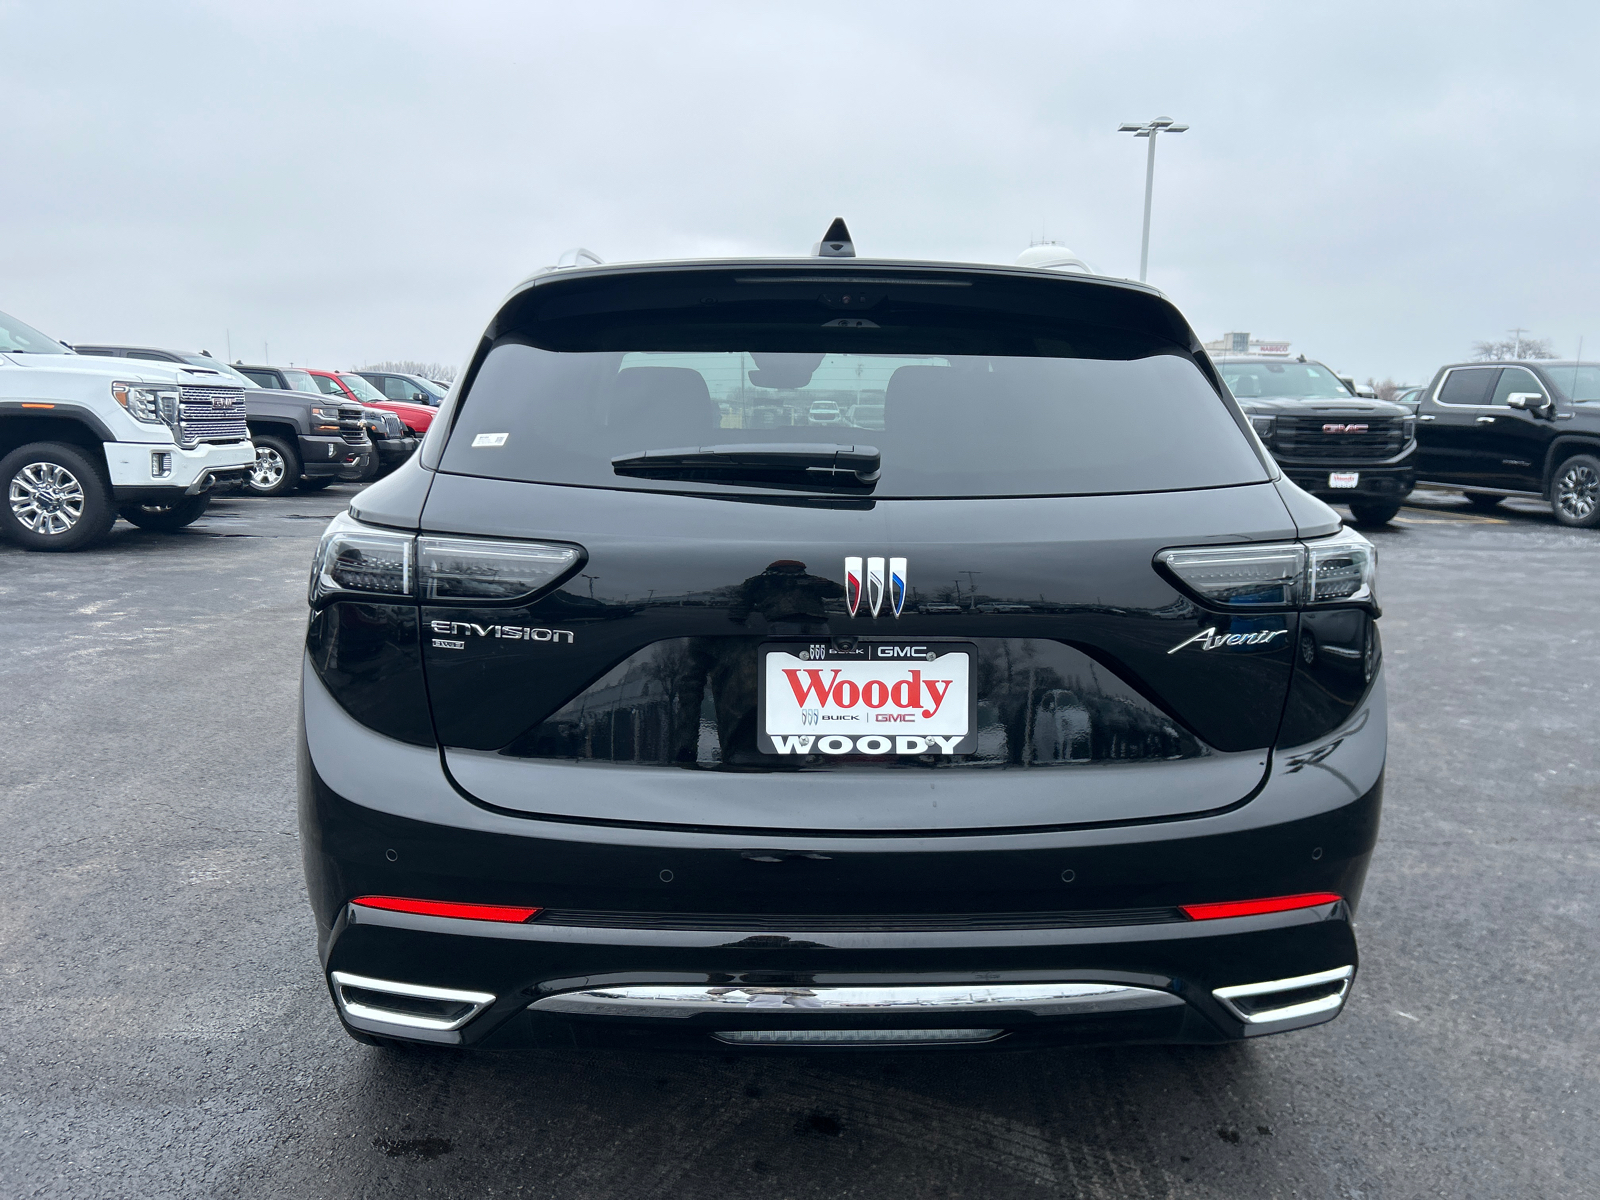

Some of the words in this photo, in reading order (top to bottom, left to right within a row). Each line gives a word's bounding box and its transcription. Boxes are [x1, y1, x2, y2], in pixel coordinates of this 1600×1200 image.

[1322, 423, 1369, 434] GMC
[1166, 626, 1289, 655] Avenir
[877, 646, 927, 657] GMC
[781, 668, 953, 719] Woody
[875, 713, 916, 723] GMC
[769, 735, 965, 755] WOODY
